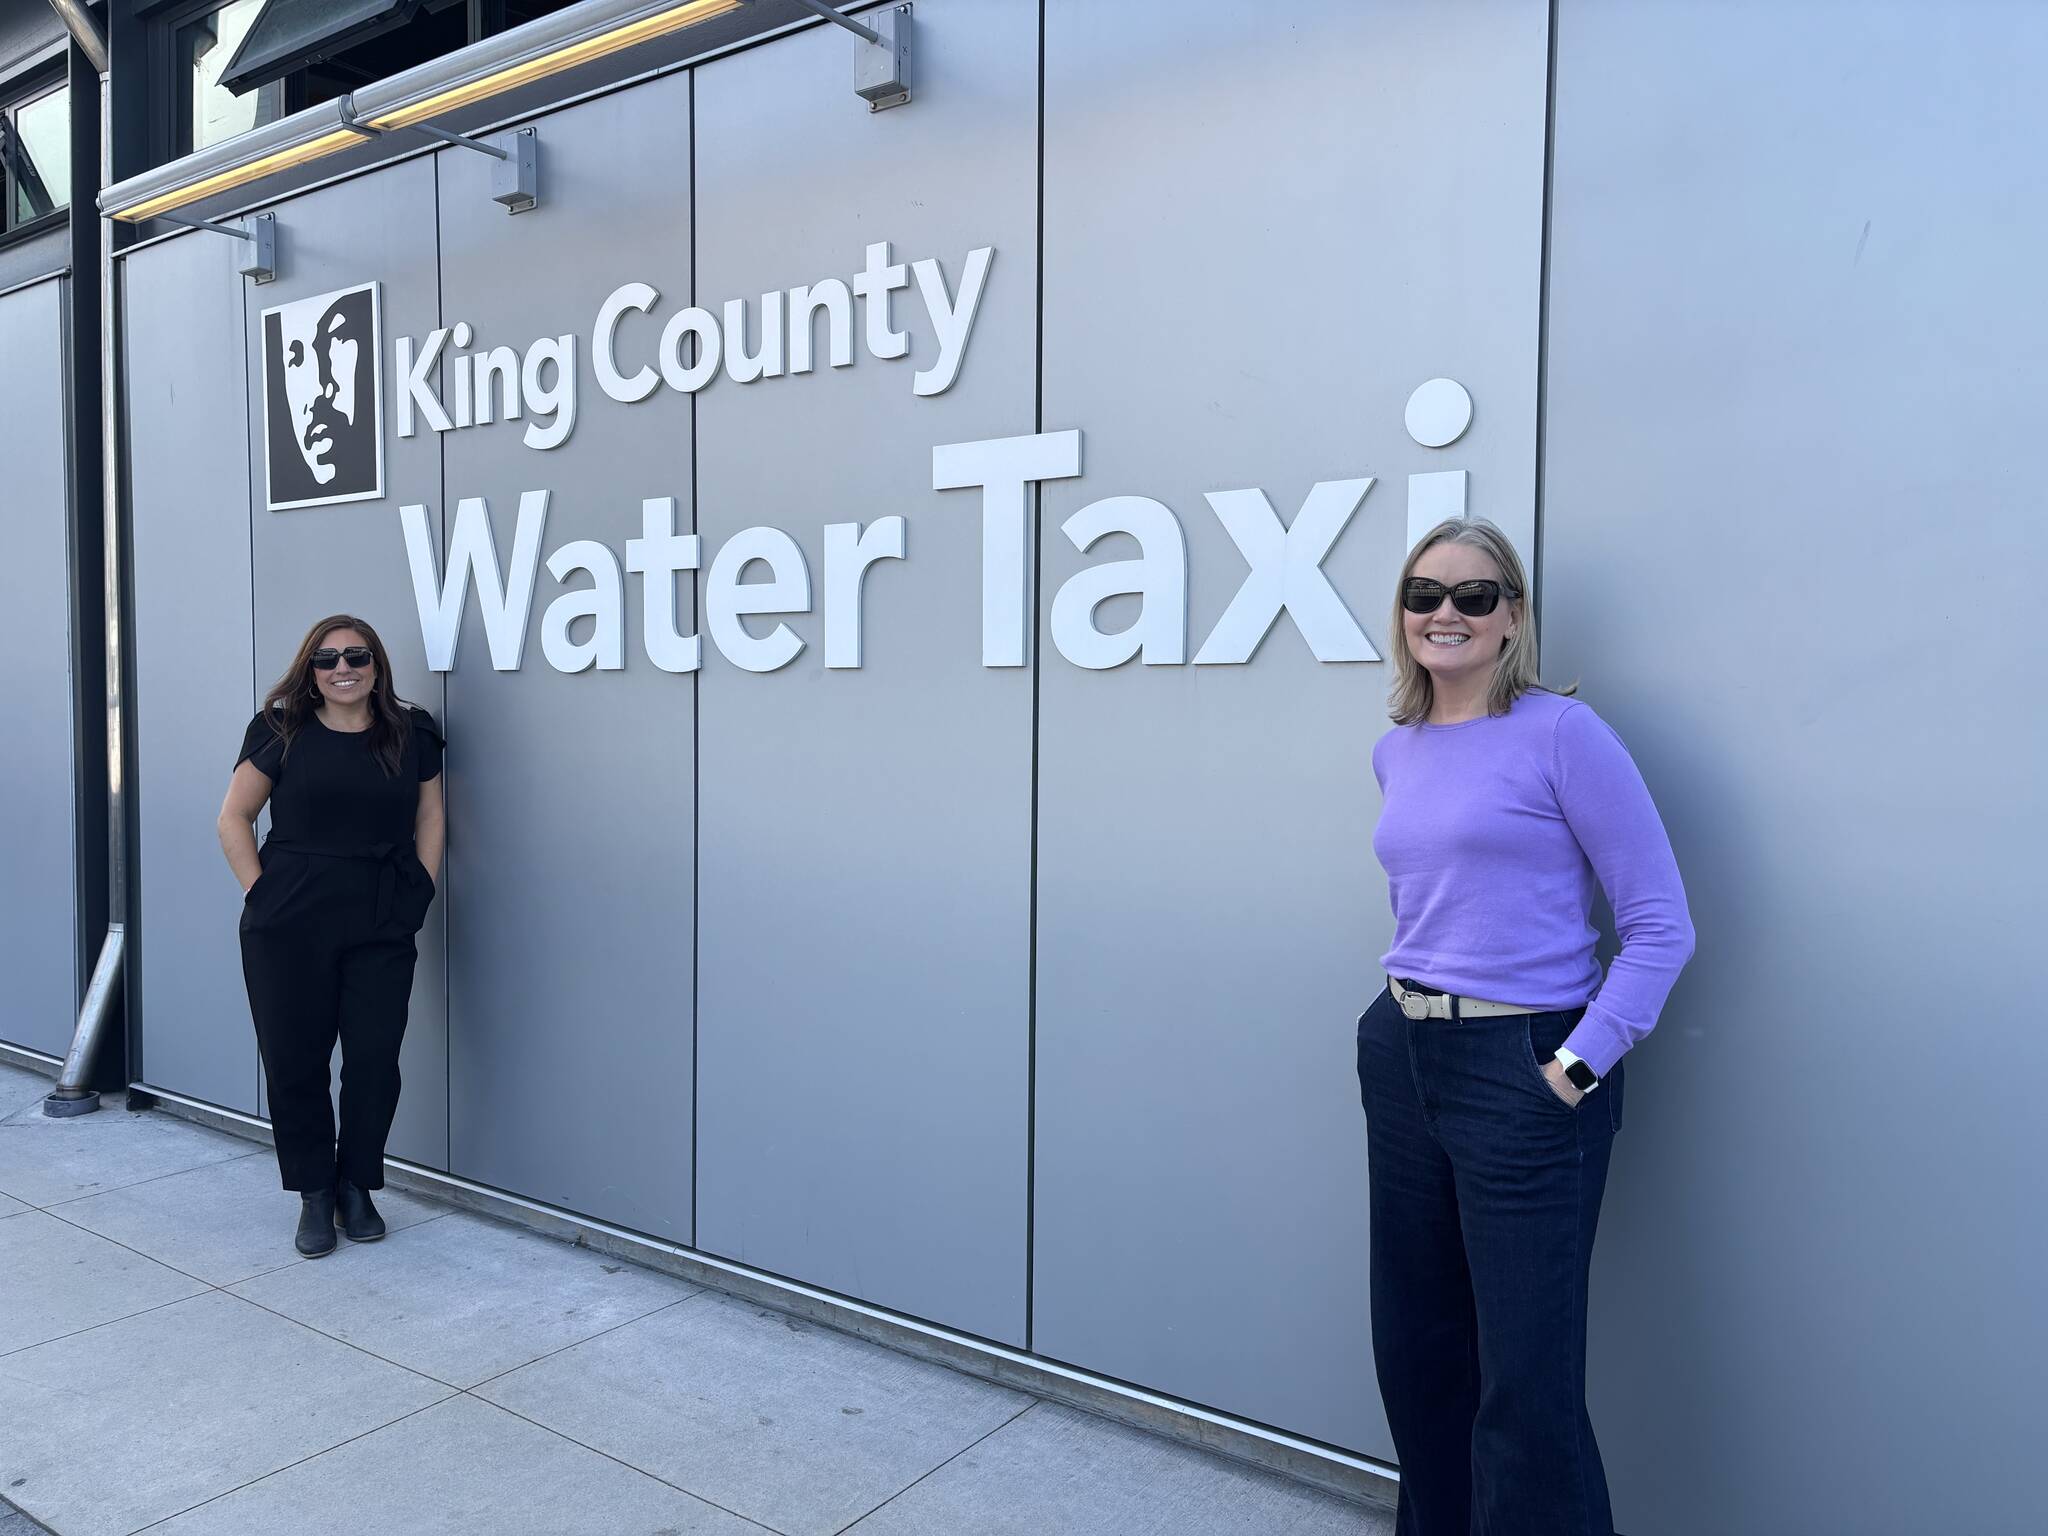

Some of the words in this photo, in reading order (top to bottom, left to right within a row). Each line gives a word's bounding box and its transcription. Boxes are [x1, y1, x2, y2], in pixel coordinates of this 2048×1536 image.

[396, 321, 577, 451] King
[592, 241, 996, 403] County
[400, 489, 906, 674] Water
